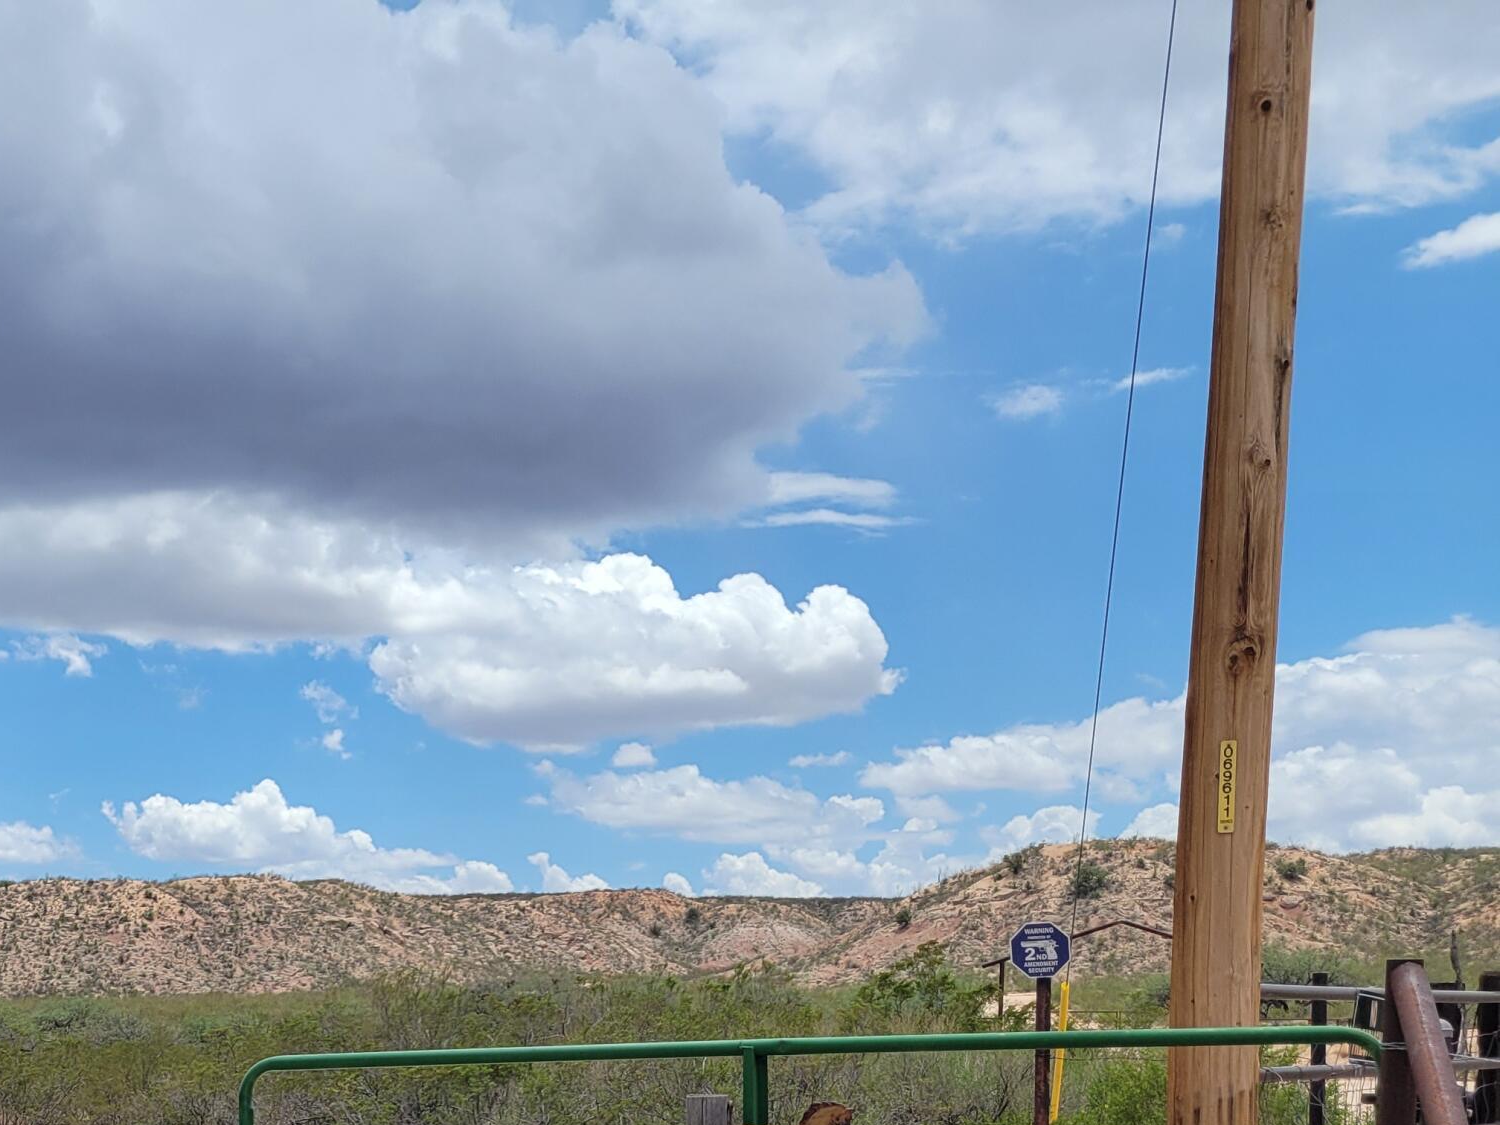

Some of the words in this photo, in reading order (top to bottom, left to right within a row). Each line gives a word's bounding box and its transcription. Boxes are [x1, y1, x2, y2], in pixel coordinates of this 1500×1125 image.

[1024, 927, 1054, 936] WARNING
[1023, 960, 1059, 968] AMENDMENT
[1028, 966, 1055, 974] SECURITY
